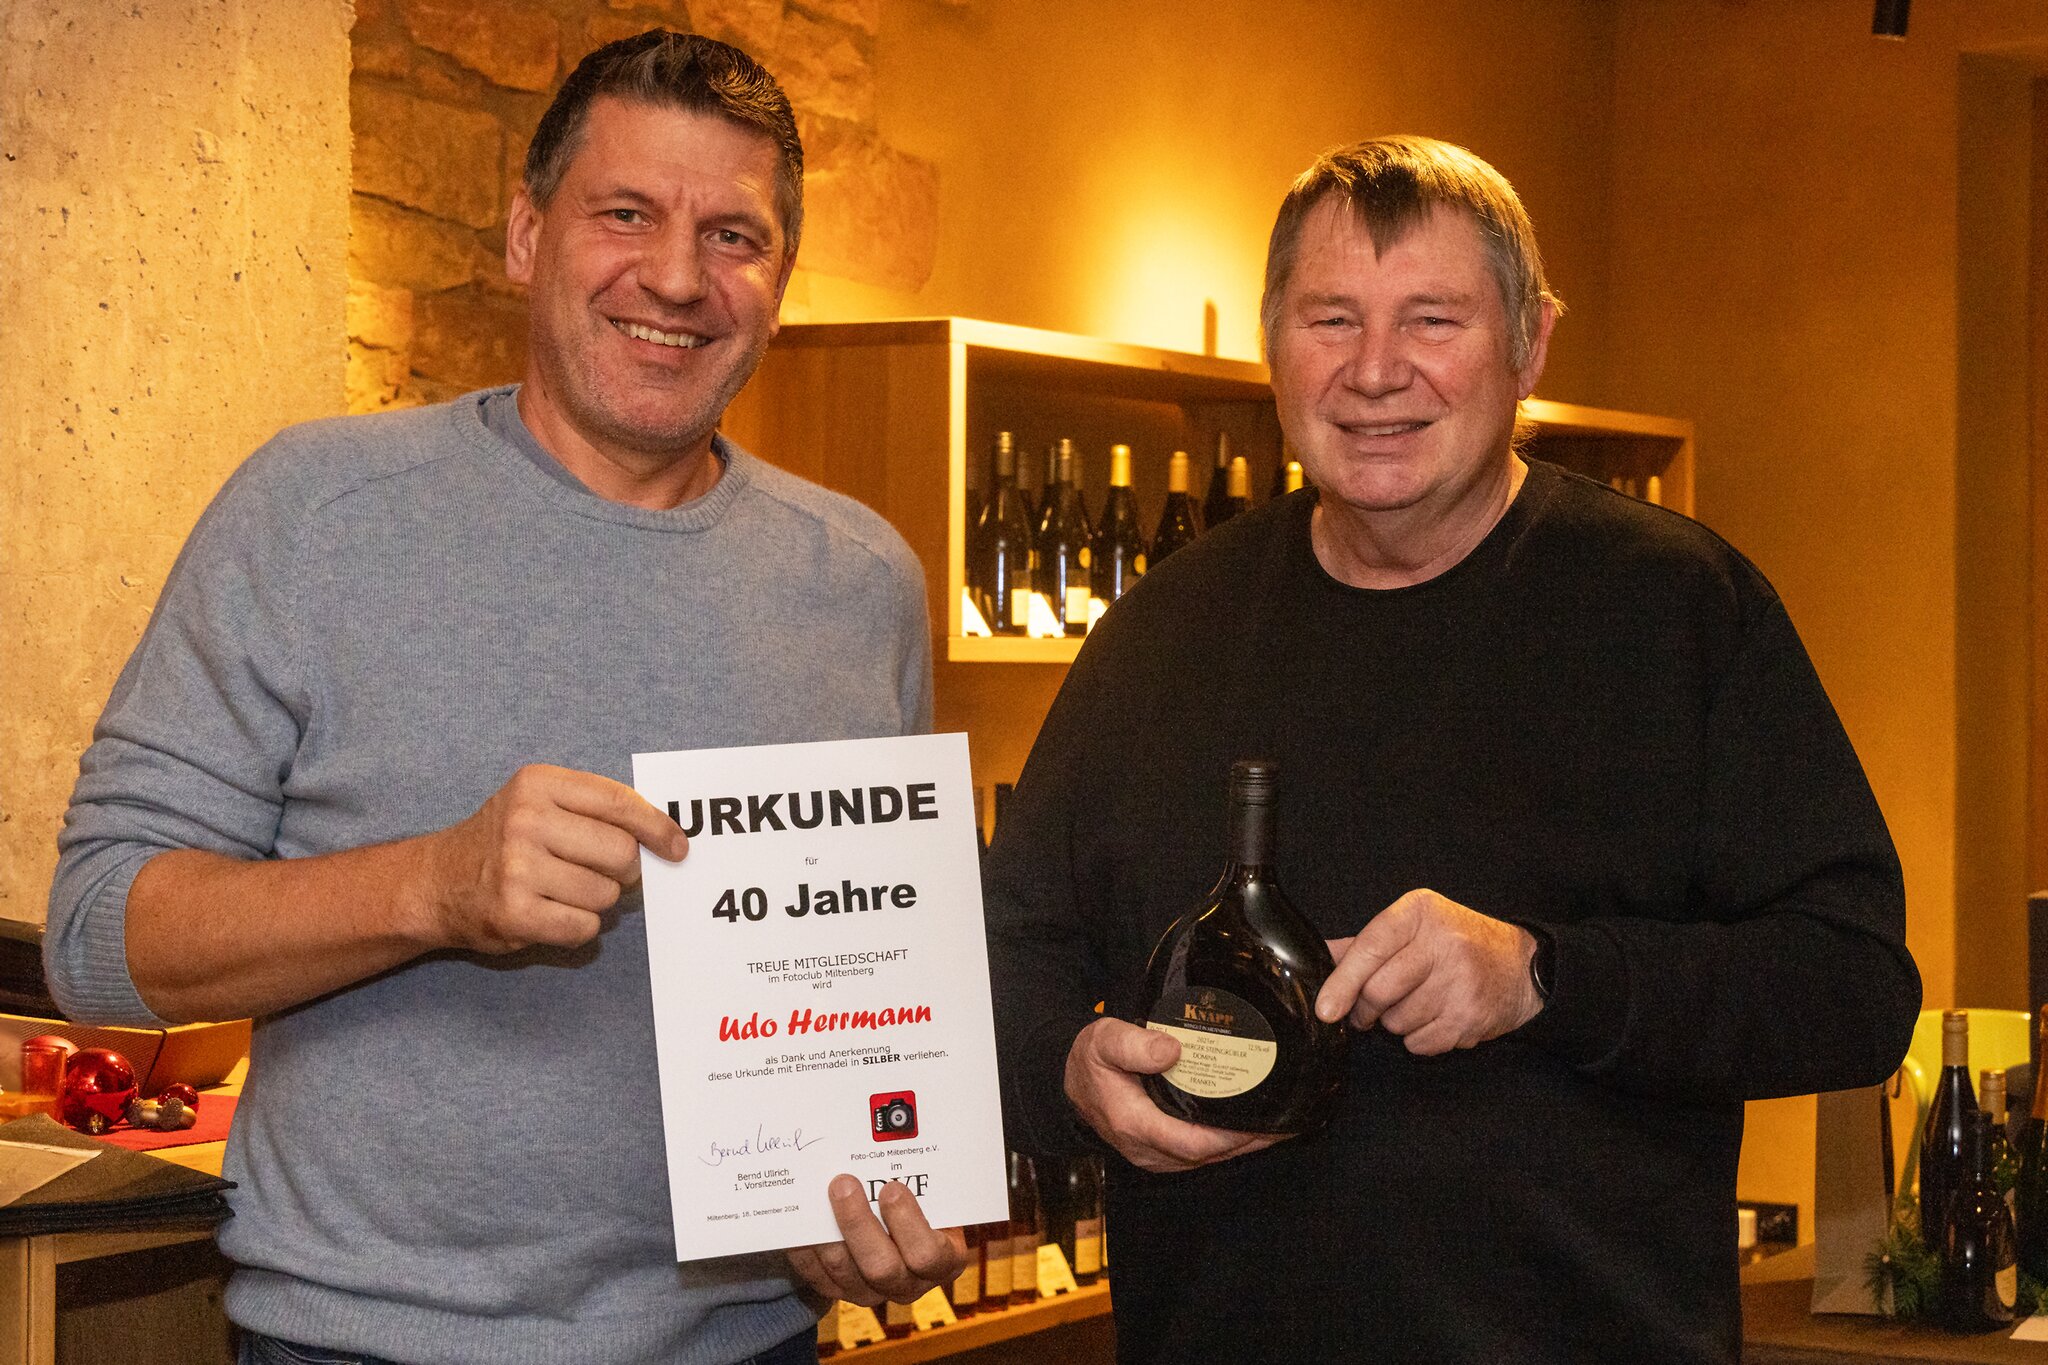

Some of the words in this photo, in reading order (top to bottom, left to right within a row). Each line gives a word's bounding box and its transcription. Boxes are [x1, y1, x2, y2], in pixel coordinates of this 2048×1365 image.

[667, 782, 939, 838] URKUNDE
[805, 856, 819, 866] für
[711, 886, 769, 923] 40
[784, 879, 918, 919] Jahre
[747, 959, 790, 974] TREUE
[794, 948, 909, 970] MITGLIEDSCHAFT
[768, 974, 780, 984] im
[783, 970, 823, 982] Fotoclub
[825, 966, 875, 979] Miltenberg
[812, 980, 833, 990] wird
[718, 1011, 778, 1042] Udo
[787, 1005, 932, 1036] Herrmann
[765, 1054, 779, 1065] als
[781, 1052, 805, 1064] Dank
[808, 1050, 826, 1061] und
[829, 1045, 891, 1060] Anerkennung
[707, 1070, 733, 1082] diese
[735, 1066, 775, 1079] Urkunde
[777, 1064, 793, 1074] mit
[796, 1058, 848, 1072] Ehrennadel
[850, 1056, 860, 1066] in
[862, 1053, 901, 1066] SILBER
[903, 1049, 949, 1063] verliehen.
[850, 1150, 886, 1161] Foto-Club
[887, 1146, 924, 1157] Miltenberg
[925, 1145, 940, 1153] e.V.
[737, 1171, 762, 1182] Bernd
[763, 1168, 790, 1179] Ullrich
[890, 1162, 903, 1171] im
[733, 1183, 743, 1191] 1.
[744, 1177, 796, 1190] Vorsitzender
[706, 1213, 741, 1221] Miltenberg,
[753, 1207, 783, 1216] Dezember
[784, 1205, 800, 1213] 2024
